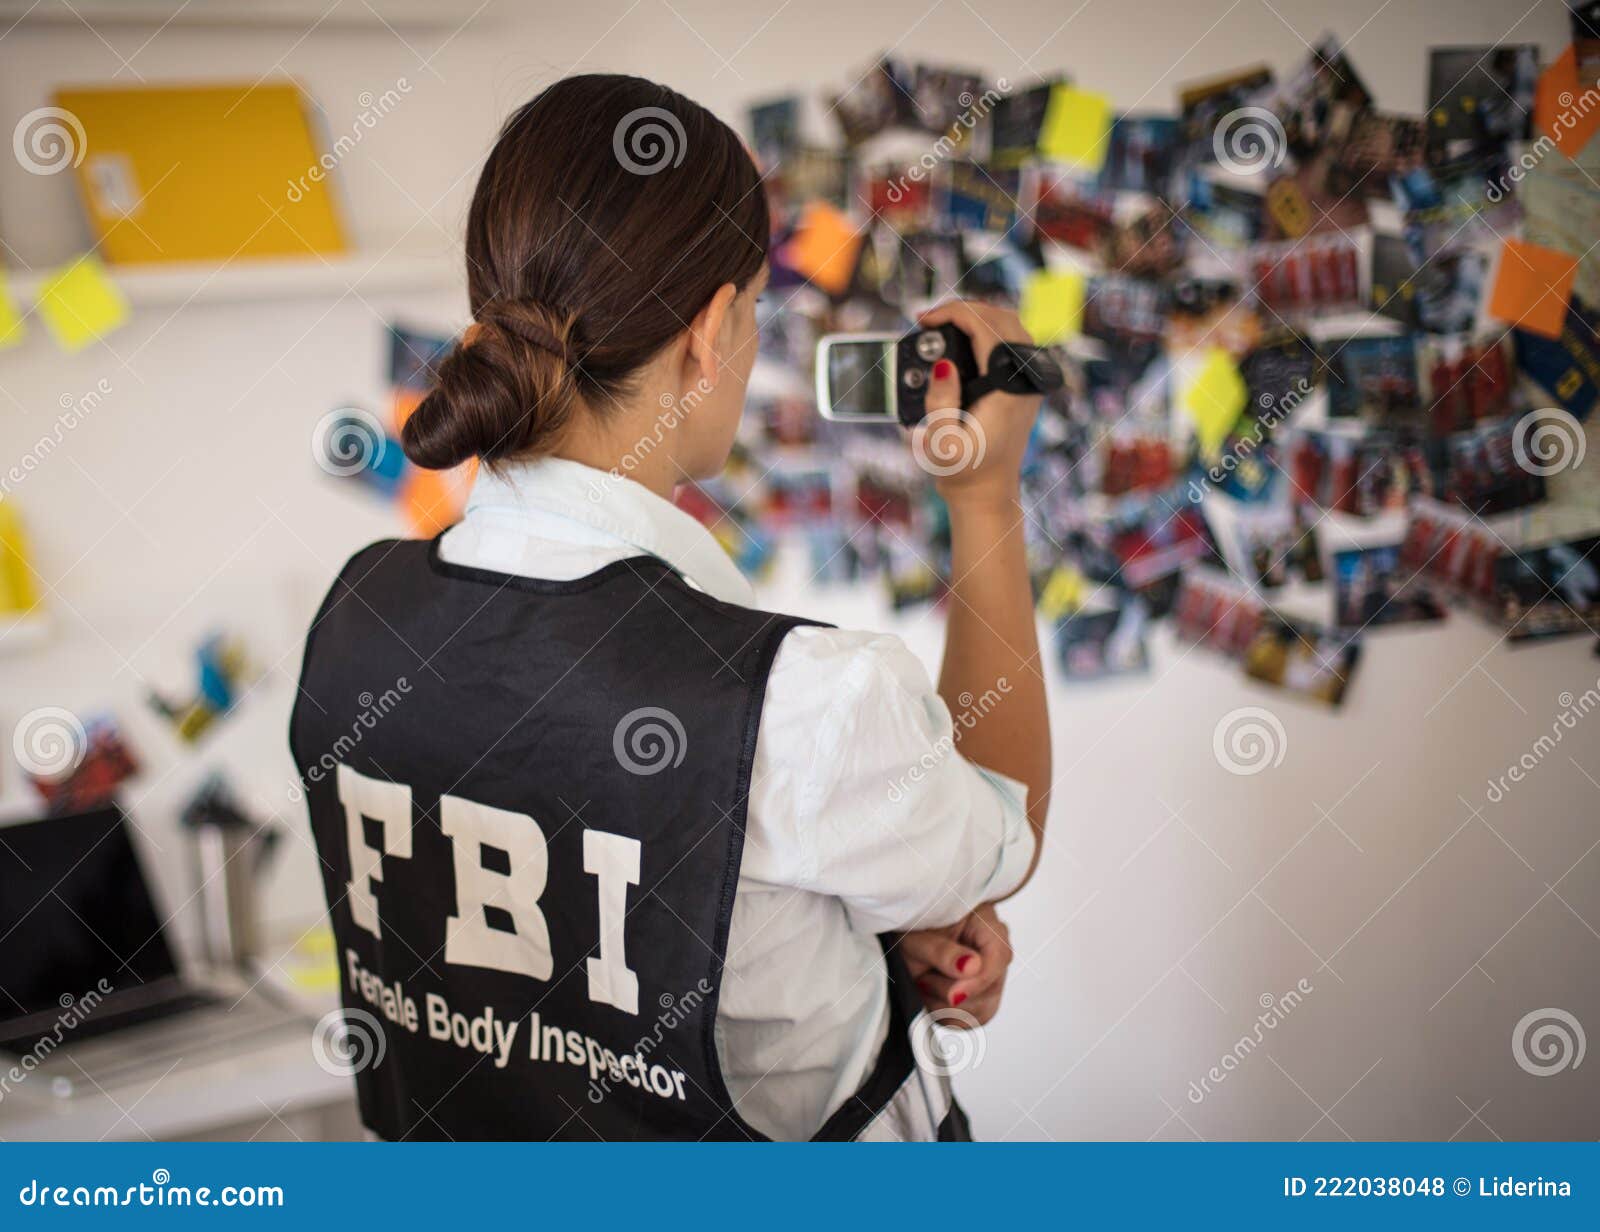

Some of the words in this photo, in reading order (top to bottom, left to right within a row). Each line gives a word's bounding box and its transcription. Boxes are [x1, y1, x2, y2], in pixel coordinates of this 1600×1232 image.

[337, 763, 641, 1016] FBI
[425, 992, 519, 1068] Body
[529, 1012, 686, 1100] Inspector
